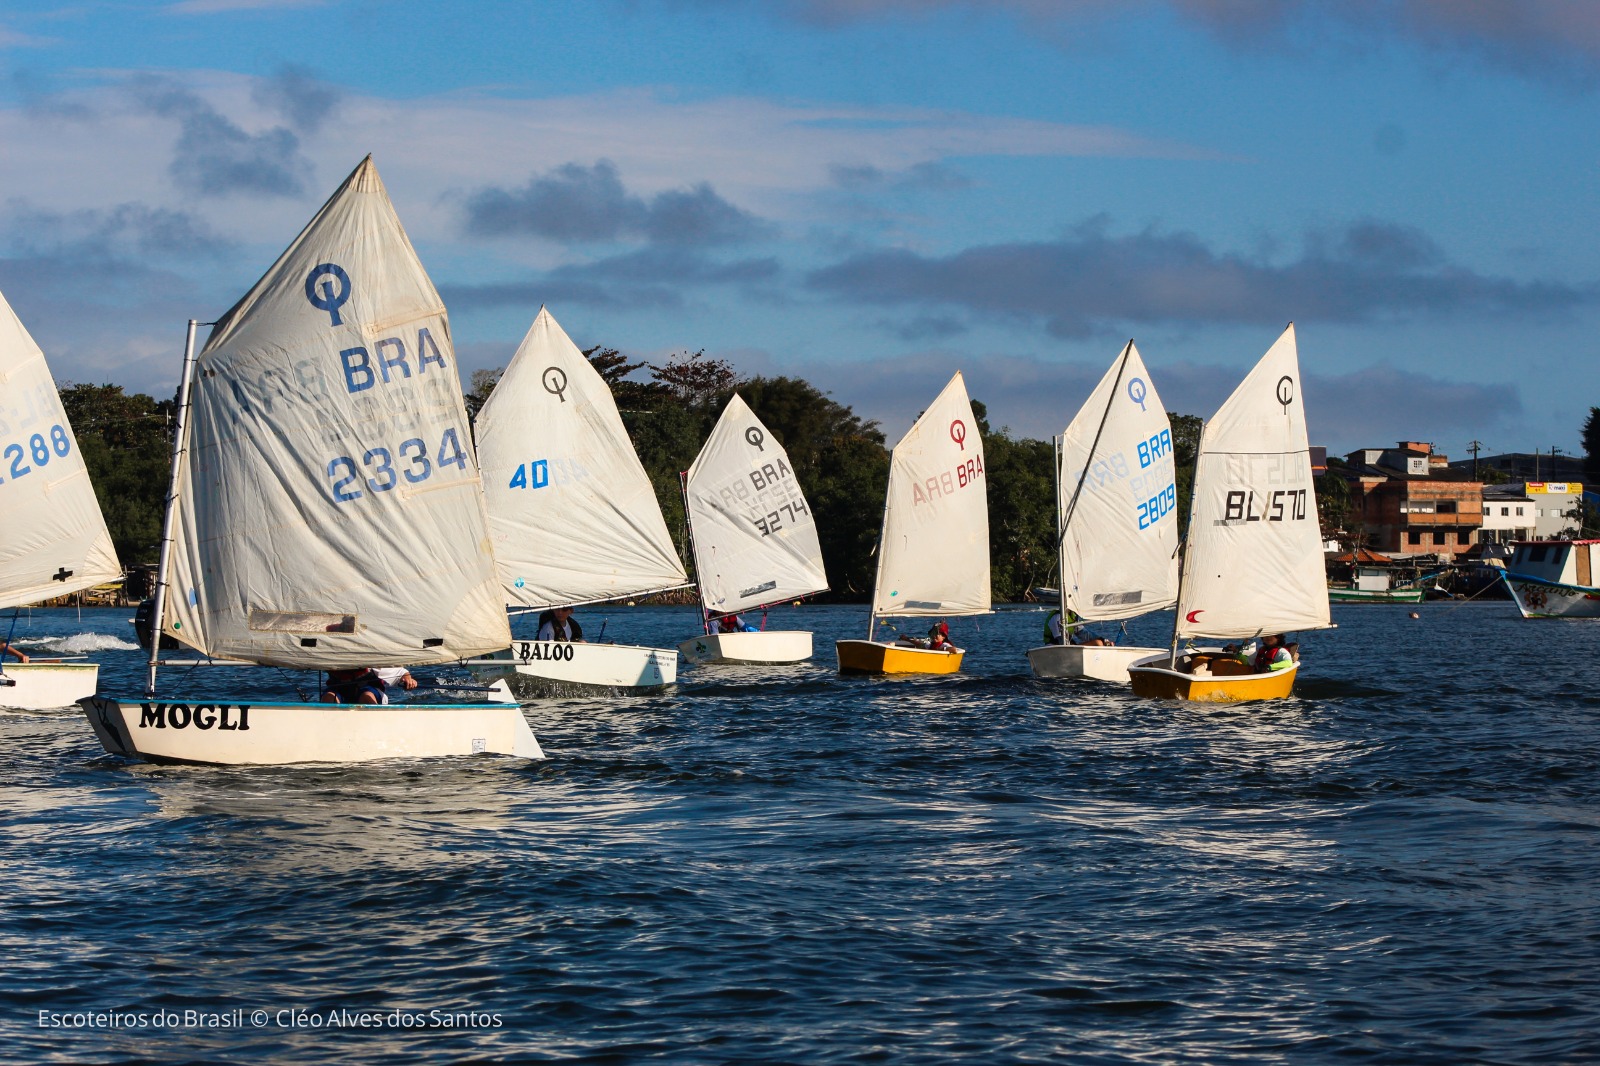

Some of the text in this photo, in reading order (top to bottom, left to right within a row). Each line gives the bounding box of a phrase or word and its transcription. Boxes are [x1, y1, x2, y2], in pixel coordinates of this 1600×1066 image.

[340, 327, 446, 393] BRA
[0, 425, 70, 486] 288
[326, 427, 467, 503] 2334
[1137, 428, 1172, 469] BRA
[508, 458, 549, 489] 40
[749, 458, 791, 491] BRA
[956, 454, 984, 488] BRA
[754, 498, 809, 537] 3274
[1136, 483, 1176, 530] 2809
[519, 642, 575, 662] BALOO
[138, 702, 251, 731] MOGLI
